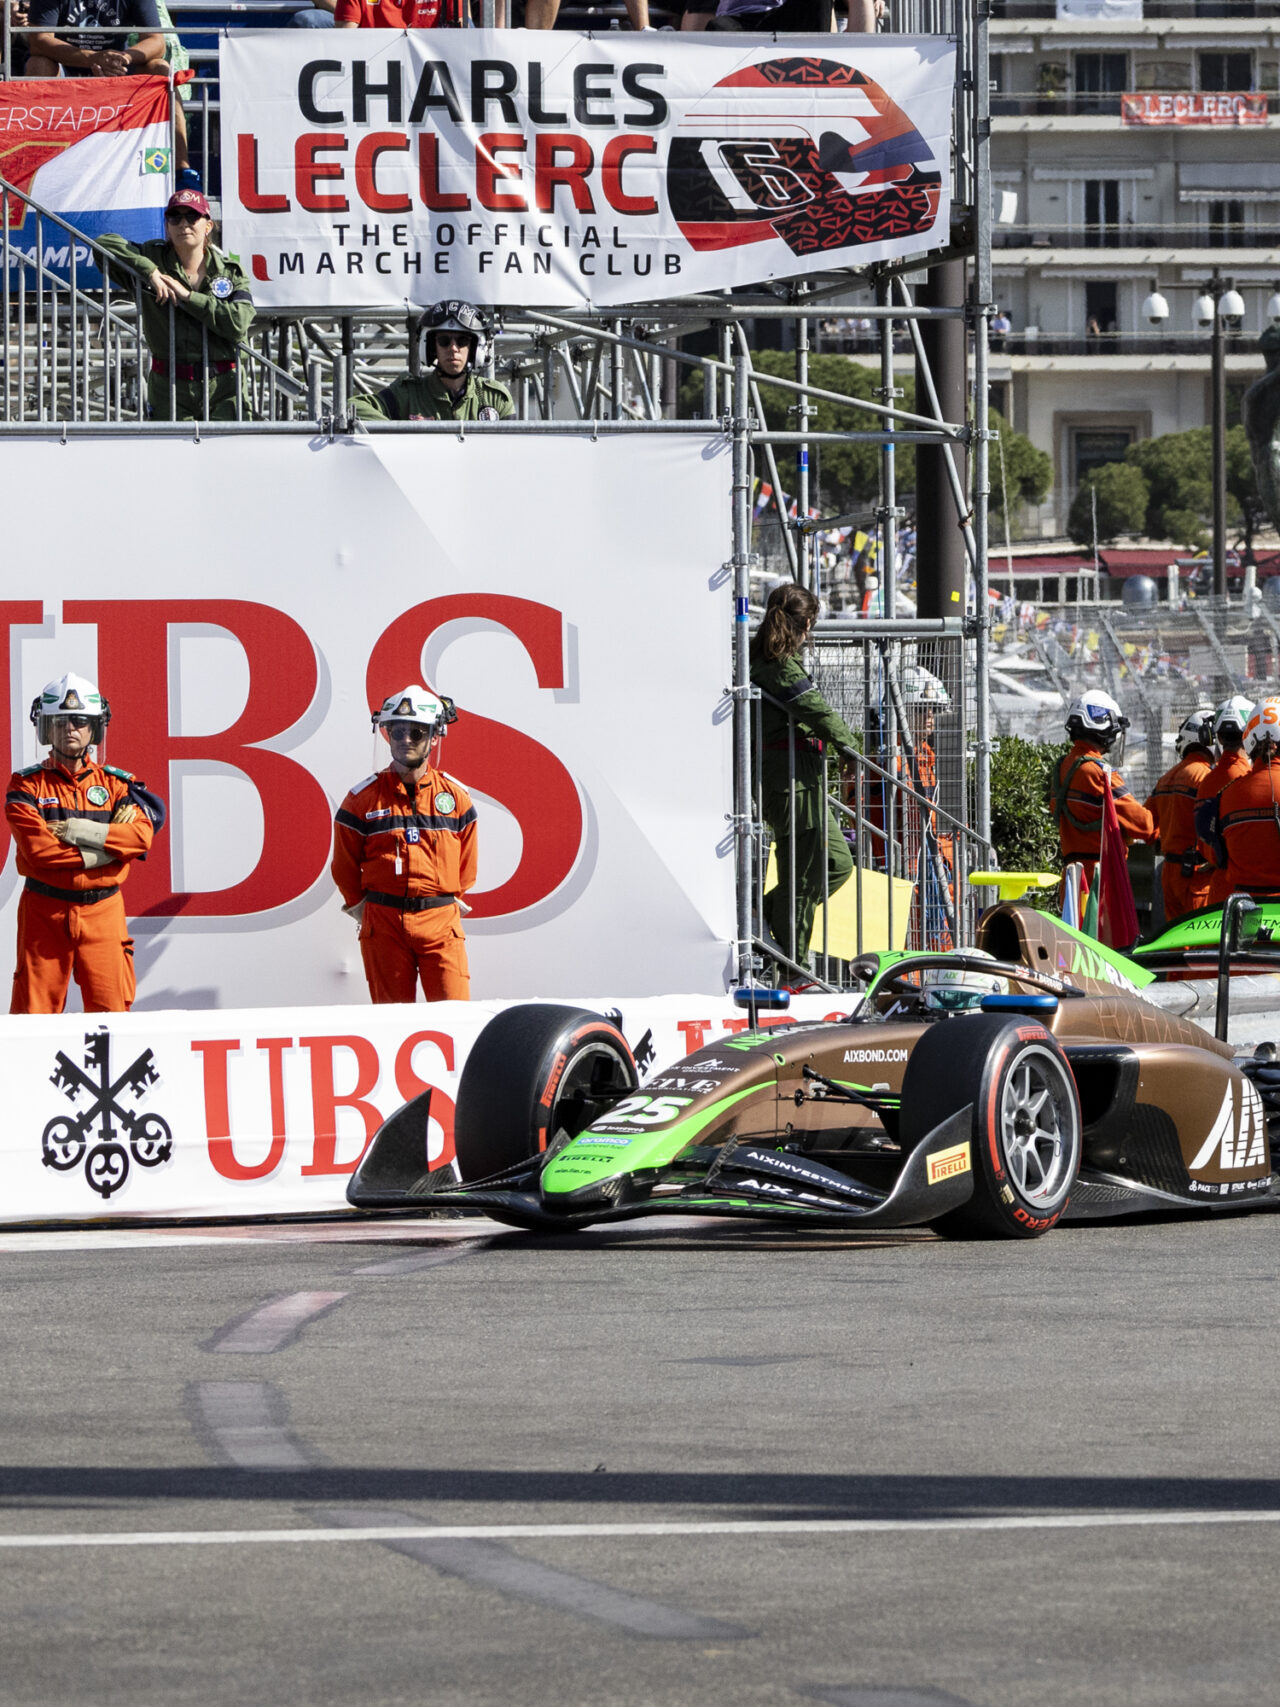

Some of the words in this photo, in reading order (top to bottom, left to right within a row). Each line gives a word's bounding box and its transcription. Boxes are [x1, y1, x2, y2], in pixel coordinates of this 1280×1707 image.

[298, 59, 670, 127] CHARLES
[1143, 95, 1247, 118] LECLERC
[237, 131, 659, 214] LECLERC
[332, 223, 408, 246] THE
[436, 223, 628, 248] OFFICIAL
[279, 252, 451, 274] MARCHE
[479, 251, 551, 274] FAN
[579, 253, 682, 276] CLUB
[1263, 707, 1278, 724] S
[407, 830, 420, 842] 15
[843, 1049, 908, 1062] AIXBOND.COM
[191, 1030, 458, 1181] UBS
[591, 1096, 693, 1125] 25
[559, 1154, 615, 1163] PIRELLI
[931, 1152, 967, 1180] PIRELLI
[737, 1179, 793, 1196] AIX
